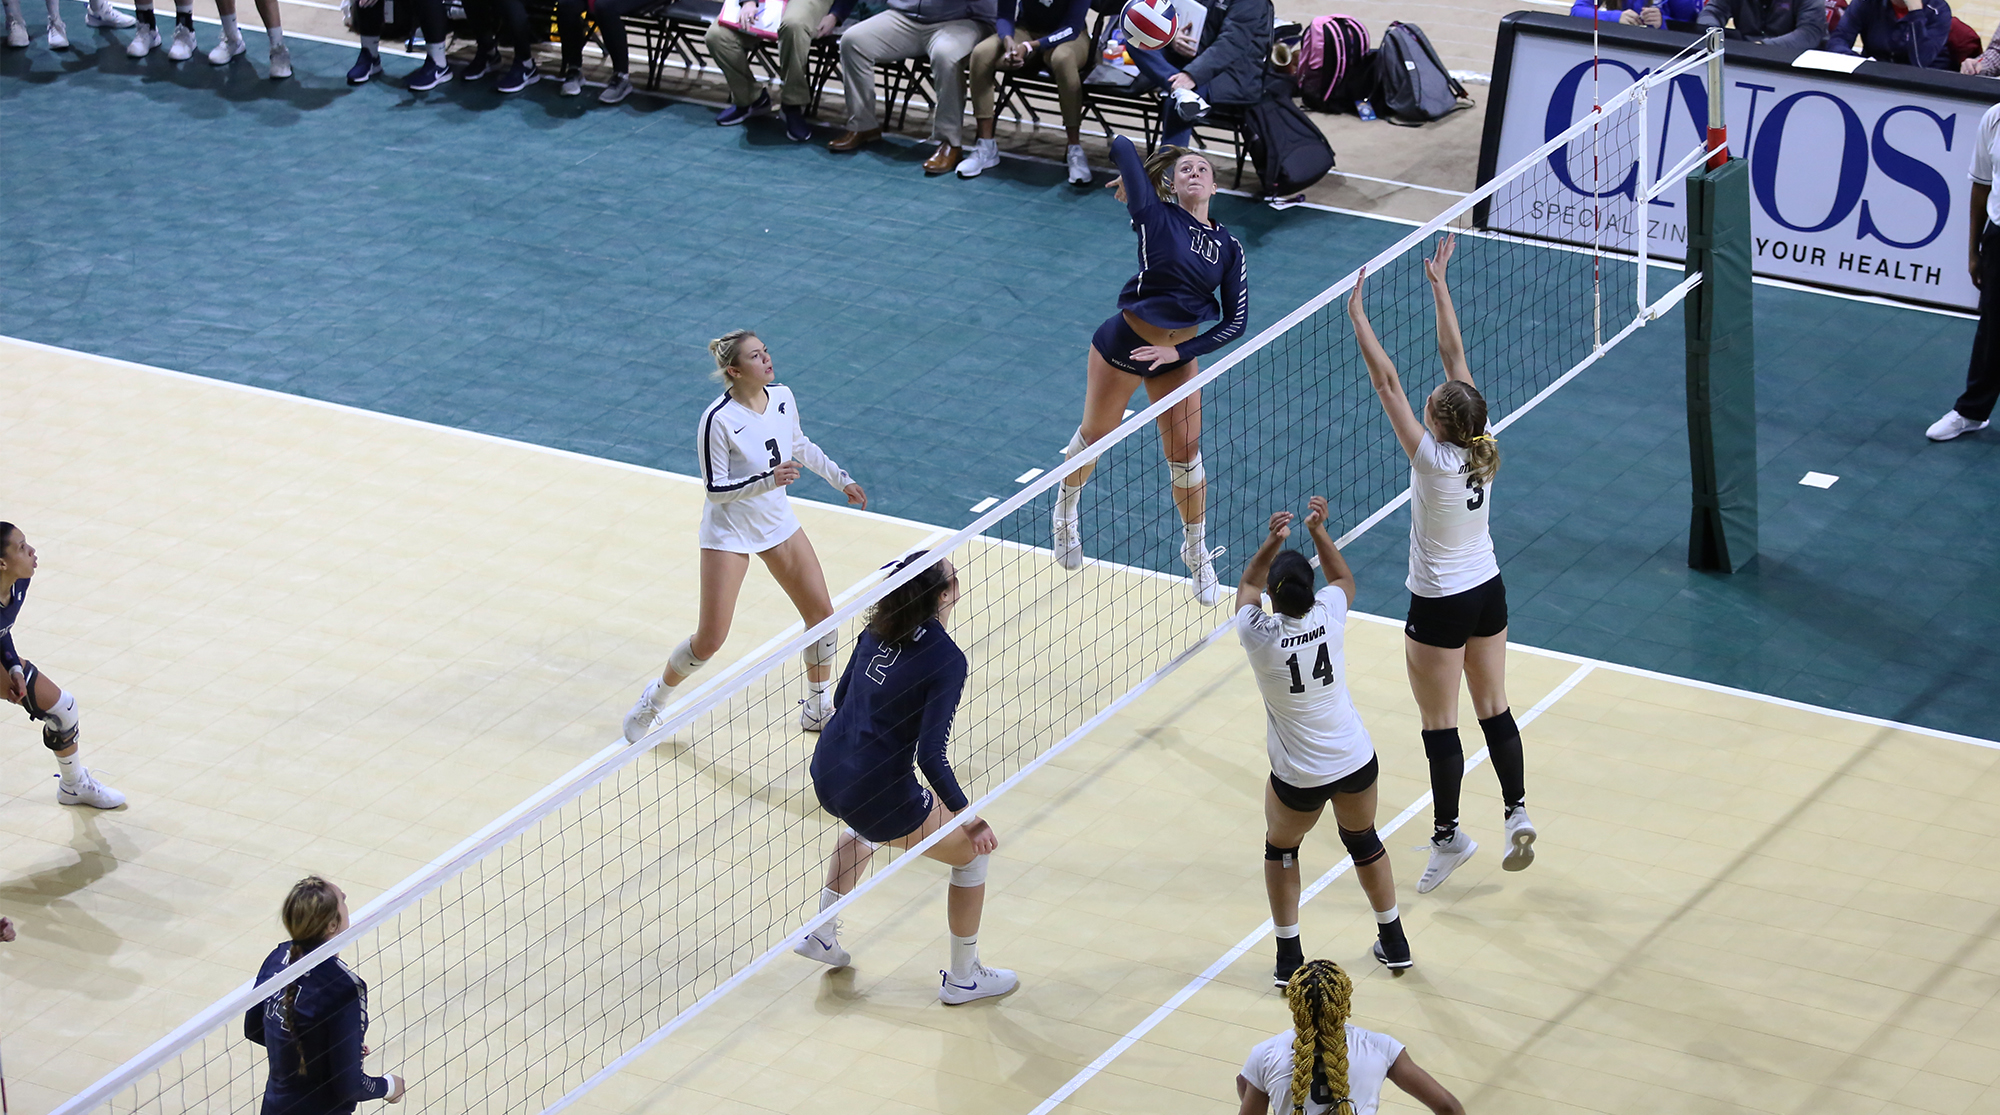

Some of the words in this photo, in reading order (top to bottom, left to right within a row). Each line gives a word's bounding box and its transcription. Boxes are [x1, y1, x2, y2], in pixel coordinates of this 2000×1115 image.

[1544, 59, 1956, 249] CNOS
[1189, 225, 1219, 264] 10
[1756, 237, 1826, 266] YOUR
[1838, 252, 1942, 285] HEALTH
[765, 438, 781, 468] 3
[1466, 473, 1484, 511] 3
[1281, 625, 1326, 648] OTTAWA
[865, 641, 902, 685] 2
[1286, 642, 1334, 693] 14
